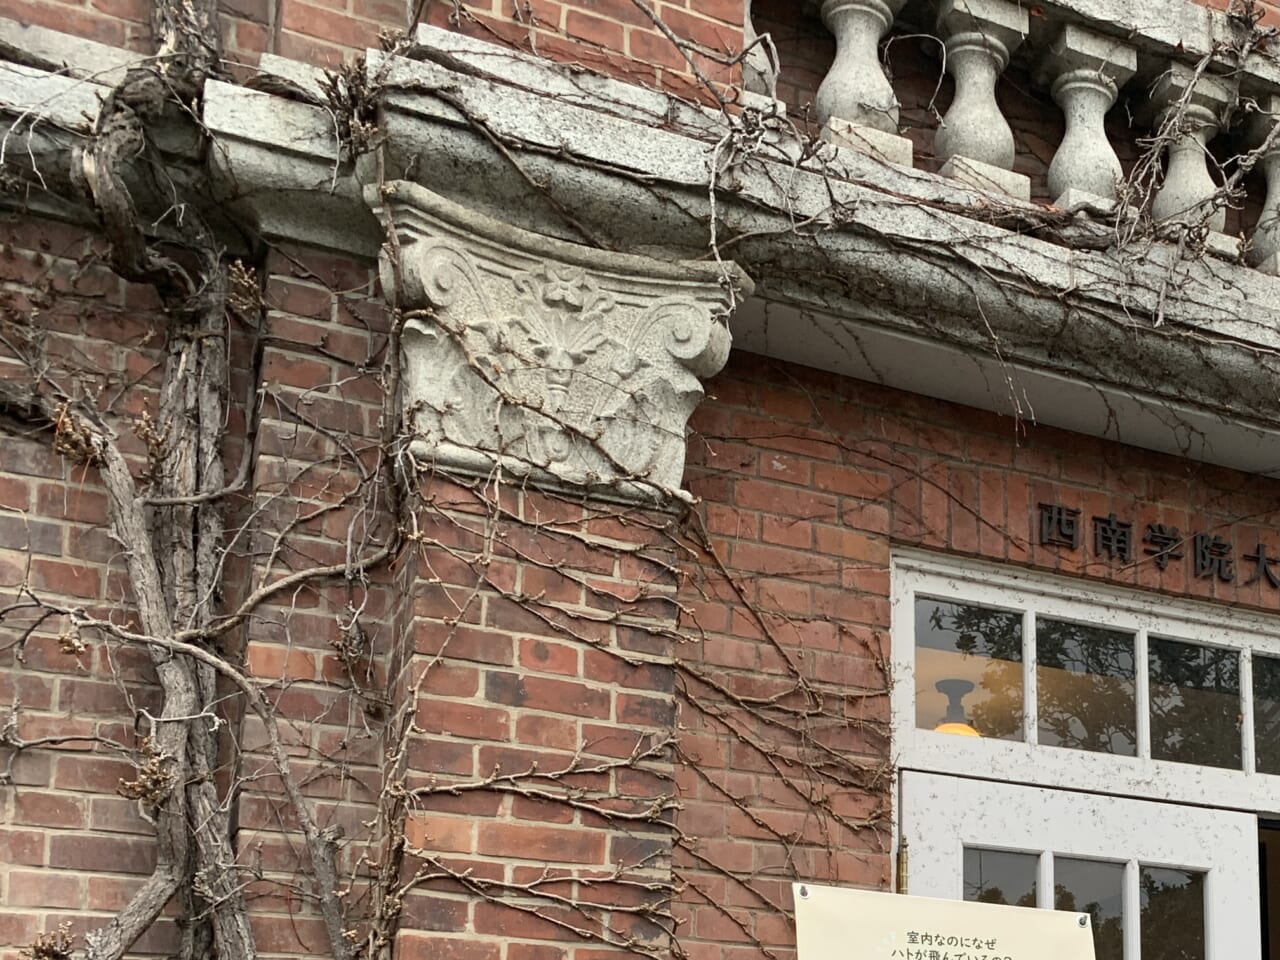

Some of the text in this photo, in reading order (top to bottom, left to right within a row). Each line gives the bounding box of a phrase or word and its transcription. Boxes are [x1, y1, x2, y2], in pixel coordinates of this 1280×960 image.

[906, 930, 997, 950] 室内なのになぜ
